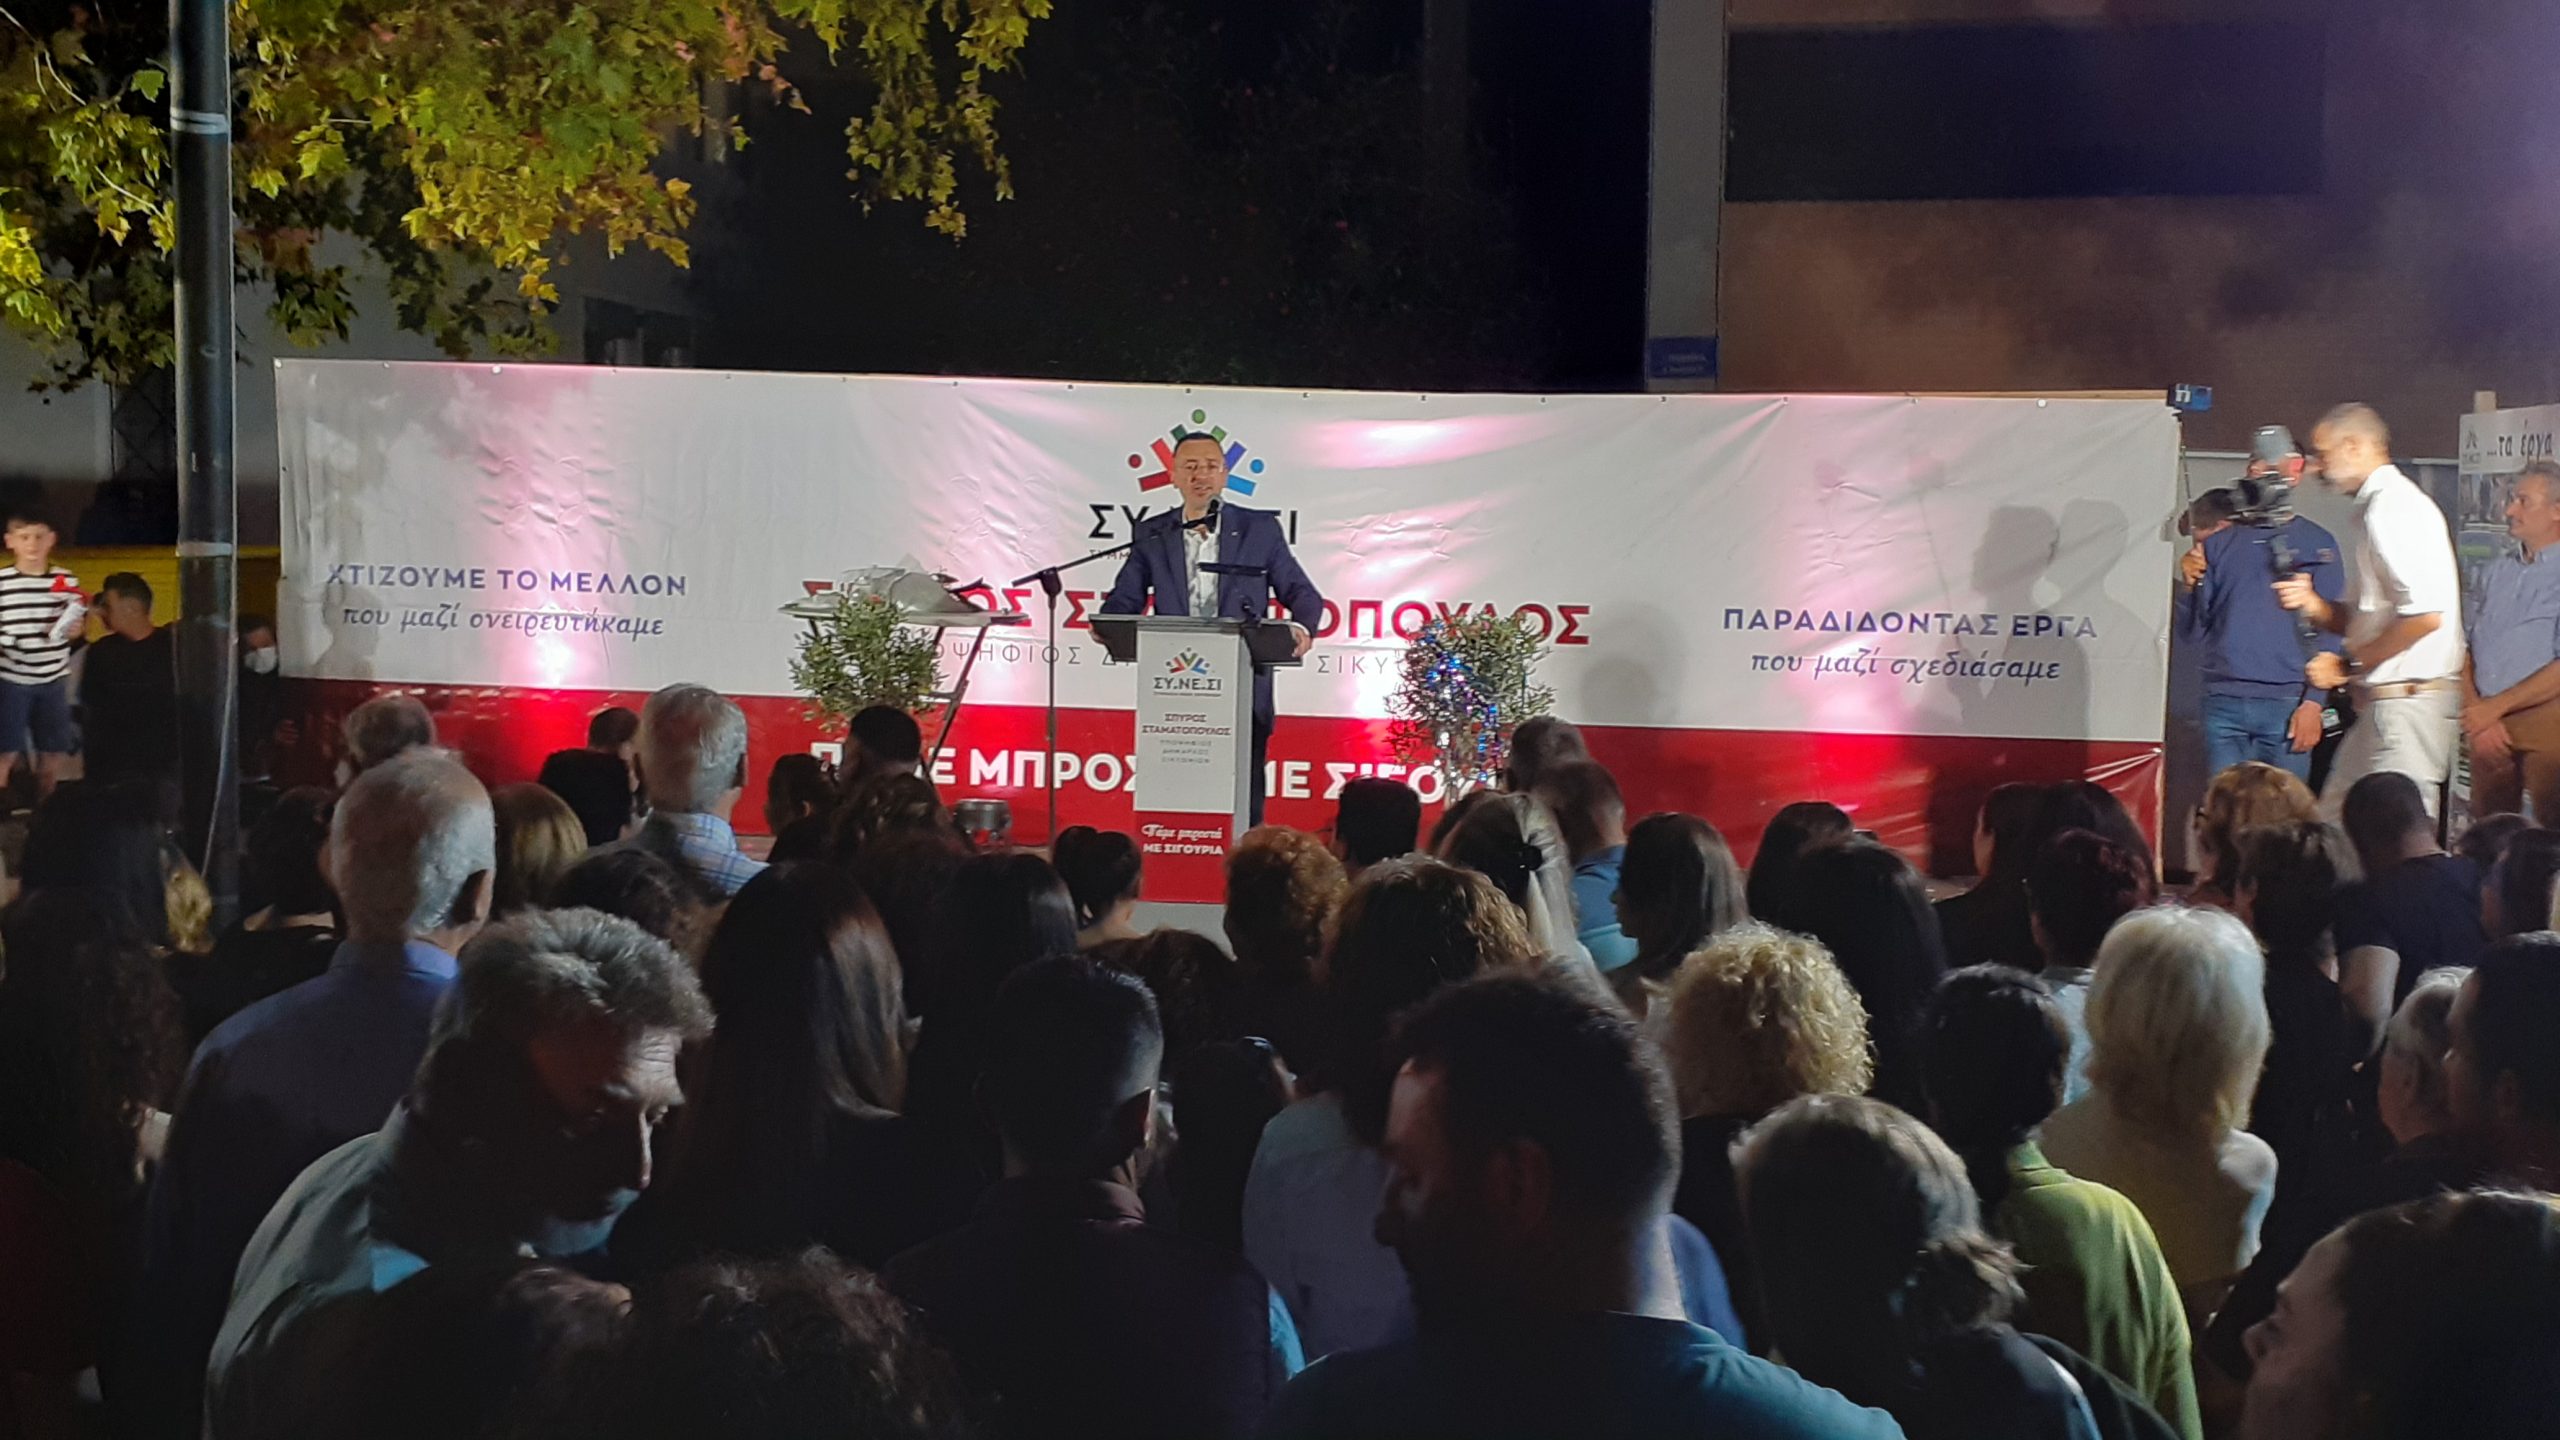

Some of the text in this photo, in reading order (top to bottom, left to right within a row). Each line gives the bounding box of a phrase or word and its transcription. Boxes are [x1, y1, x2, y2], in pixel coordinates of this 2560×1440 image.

[326, 564, 686, 597] ΧΤΙΖΟΥΜΕ ΤΟ ΜΕΛΛΟΝ
[342, 602, 665, 642] που μαζί ονειρευτήκαμε
[1722, 608, 2098, 639] ΠΑΡΑΔΙΔΟΝΤΑΣ ΕΡΓΑ
[1751, 647, 2061, 687] που μαζί σχεδιάσαμε
[1143, 843, 1163, 853] ΜΕ
